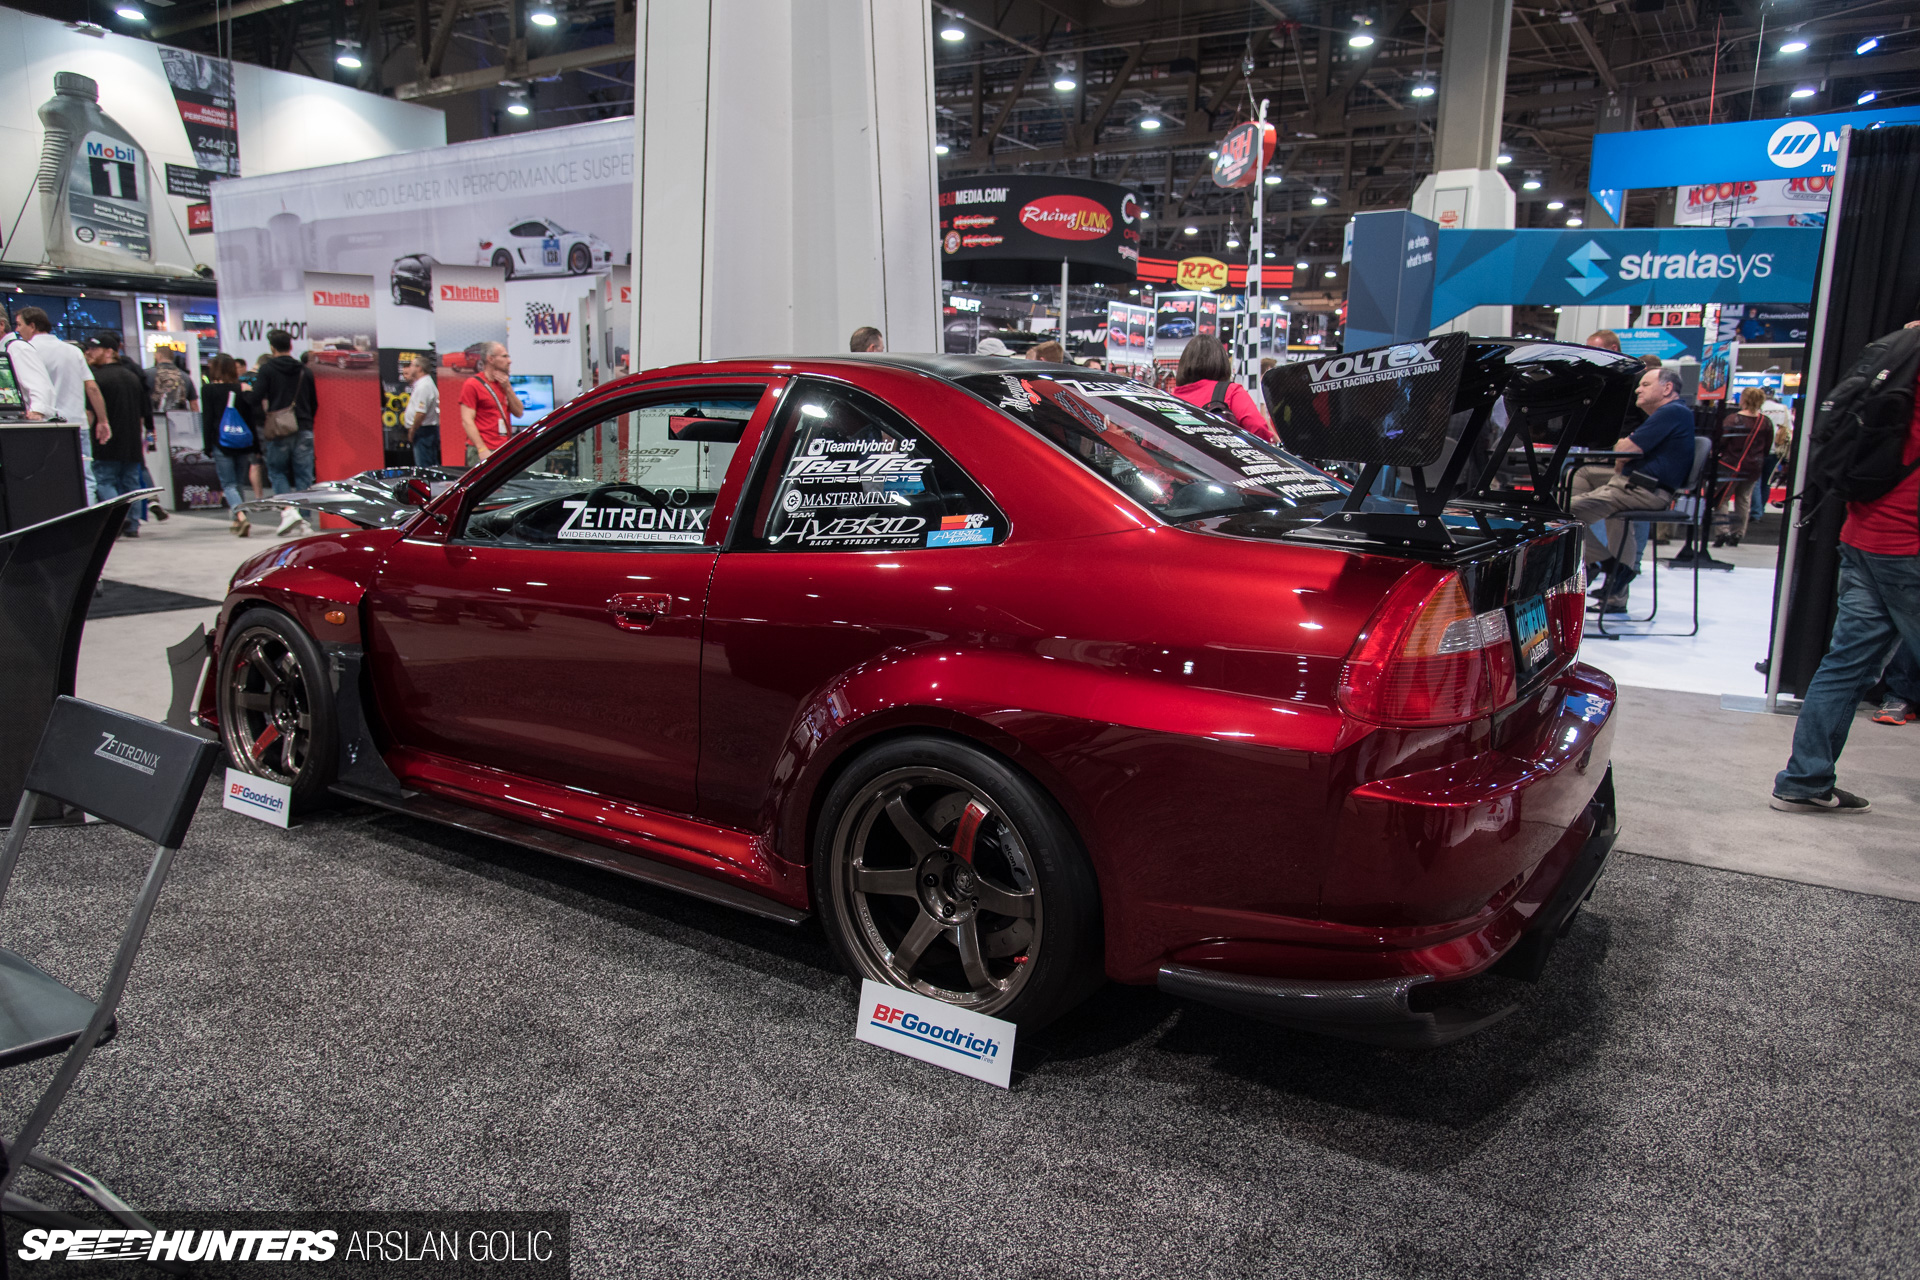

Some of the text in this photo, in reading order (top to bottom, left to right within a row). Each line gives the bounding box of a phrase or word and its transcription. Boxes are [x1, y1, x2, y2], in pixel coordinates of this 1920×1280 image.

[87, 142, 135, 162] Mobil
[102, 162, 123, 197] 1
[344, 190, 389, 211] WORLD
[392, 180, 441, 205] LEADER
[444, 178, 459, 198] IN
[463, 162, 578, 196] PERFORMANCE
[1182, 262, 1224, 280] RPC
[1619, 249, 1772, 283] stratasys
[325, 292, 370, 308] belltech
[455, 286, 499, 302] belltech
[238, 320, 264, 342] KW
[534, 312, 571, 335] KW
[1307, 339, 1439, 383] VOLTEX
[1310, 363, 1440, 393] VOLTEX RACING SUZUKA JAPAN
[782, 475, 922, 484] MOTORSPORTS
[802, 491, 900, 507] MASTERMIND
[558, 501, 706, 532] ZEITRONIX
[560, 531, 611, 539] WIDEBAND
[616, 532, 662, 540] AIR/FUEL
[770, 516, 926, 545] HYBRID
[231, 783, 284, 809] BFGoodrich
[1004, 844, 1016, 867] alcon
[872, 1003, 999, 1058] BFGoodrich
